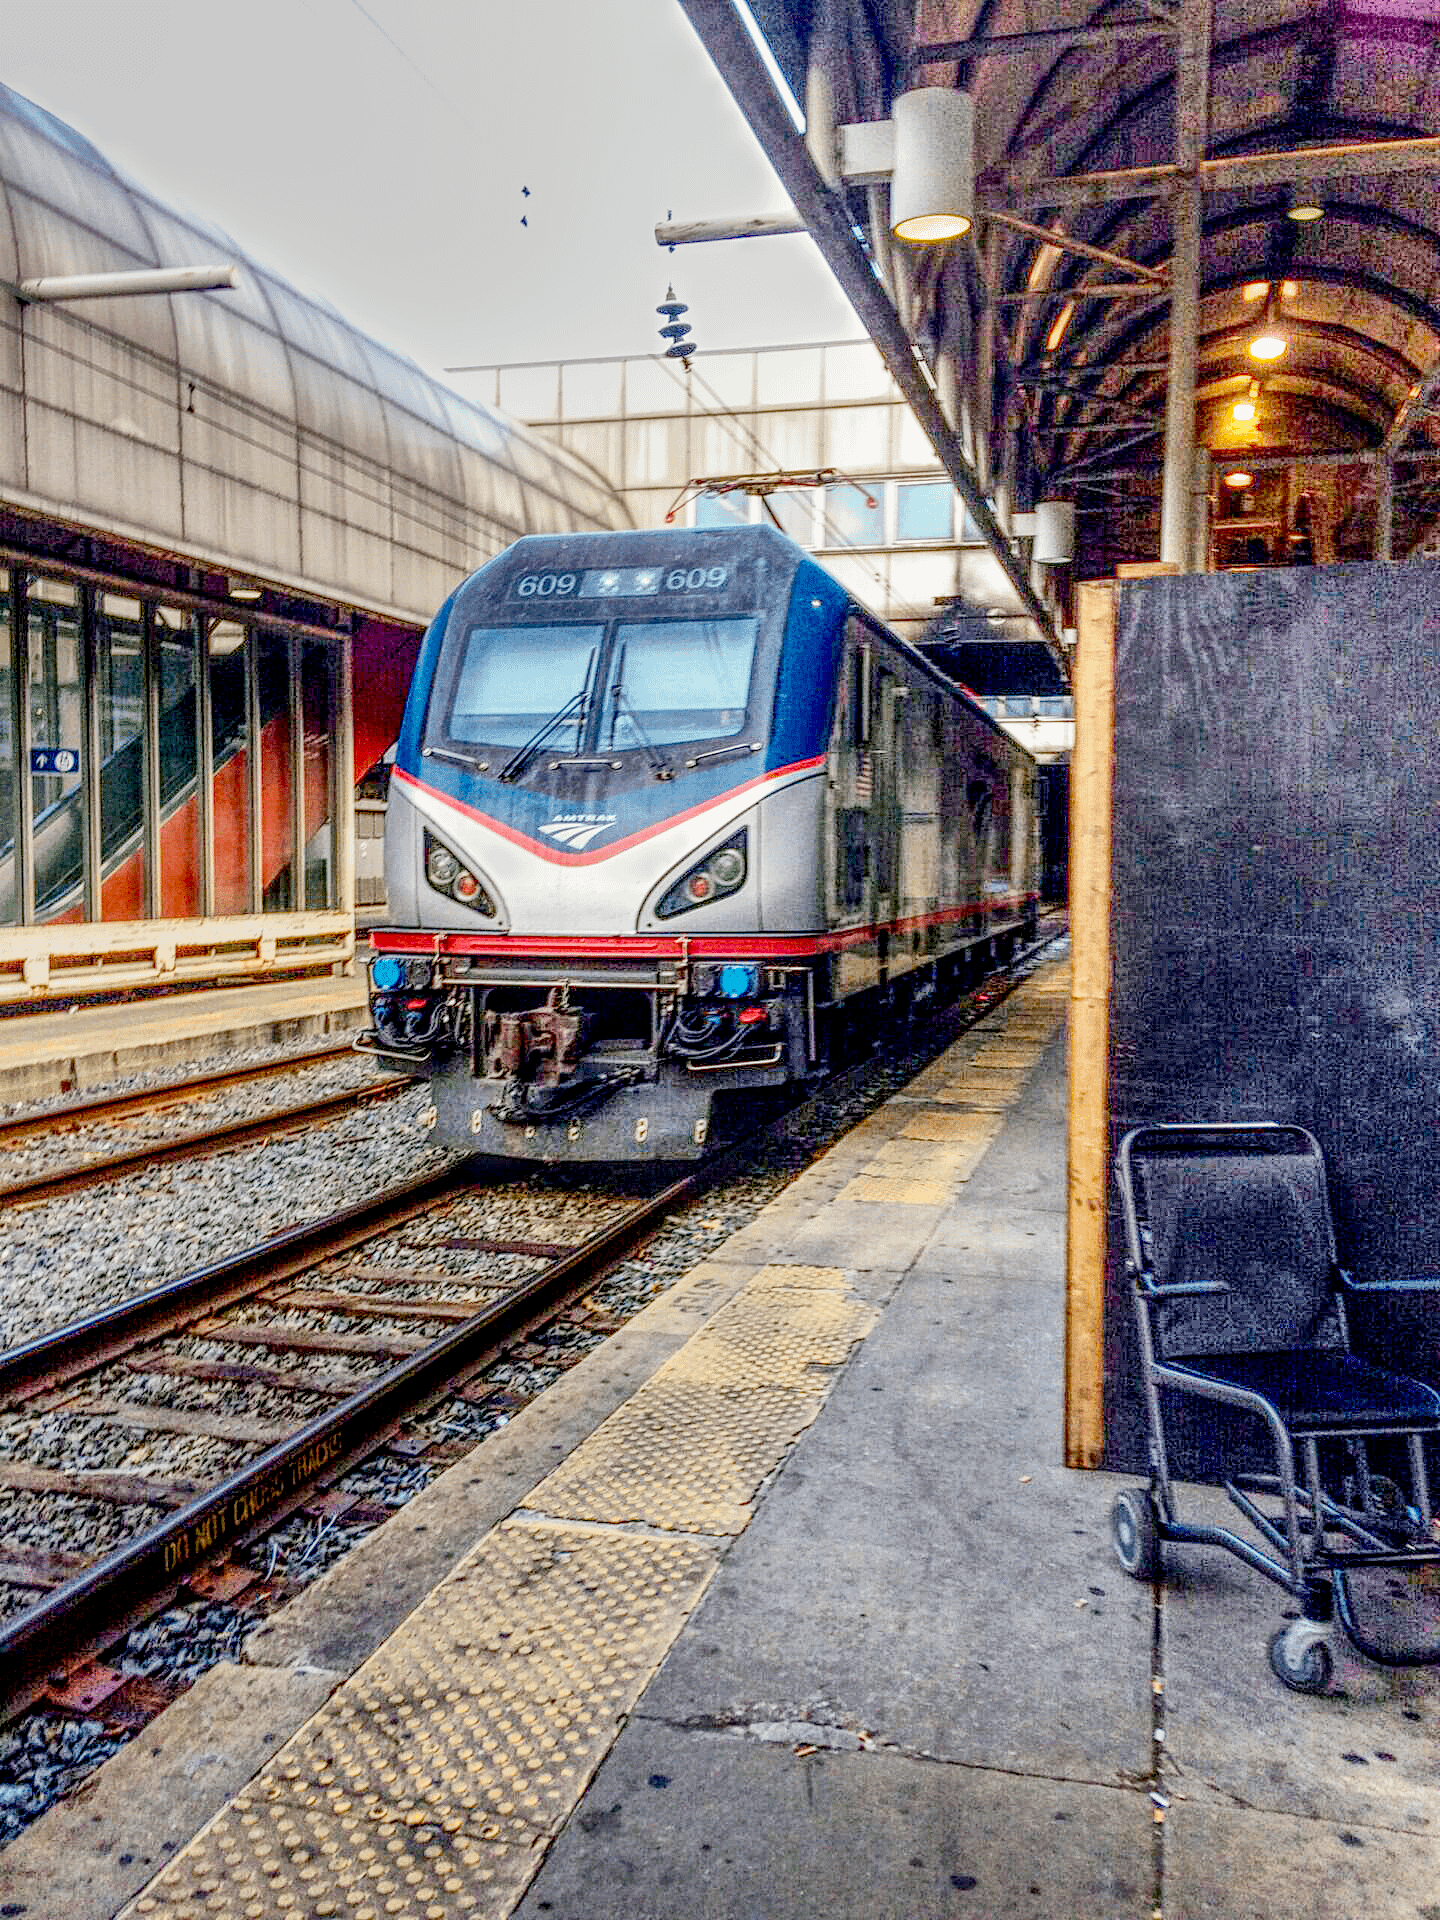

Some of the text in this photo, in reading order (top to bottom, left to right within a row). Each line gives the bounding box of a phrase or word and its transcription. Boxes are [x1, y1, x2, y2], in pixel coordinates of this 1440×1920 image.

[517, 574, 577, 597] 609
[666, 566, 728, 590] 609
[551, 814, 617, 822] AMTRAK
[195, 1505, 226, 1554] NOT
